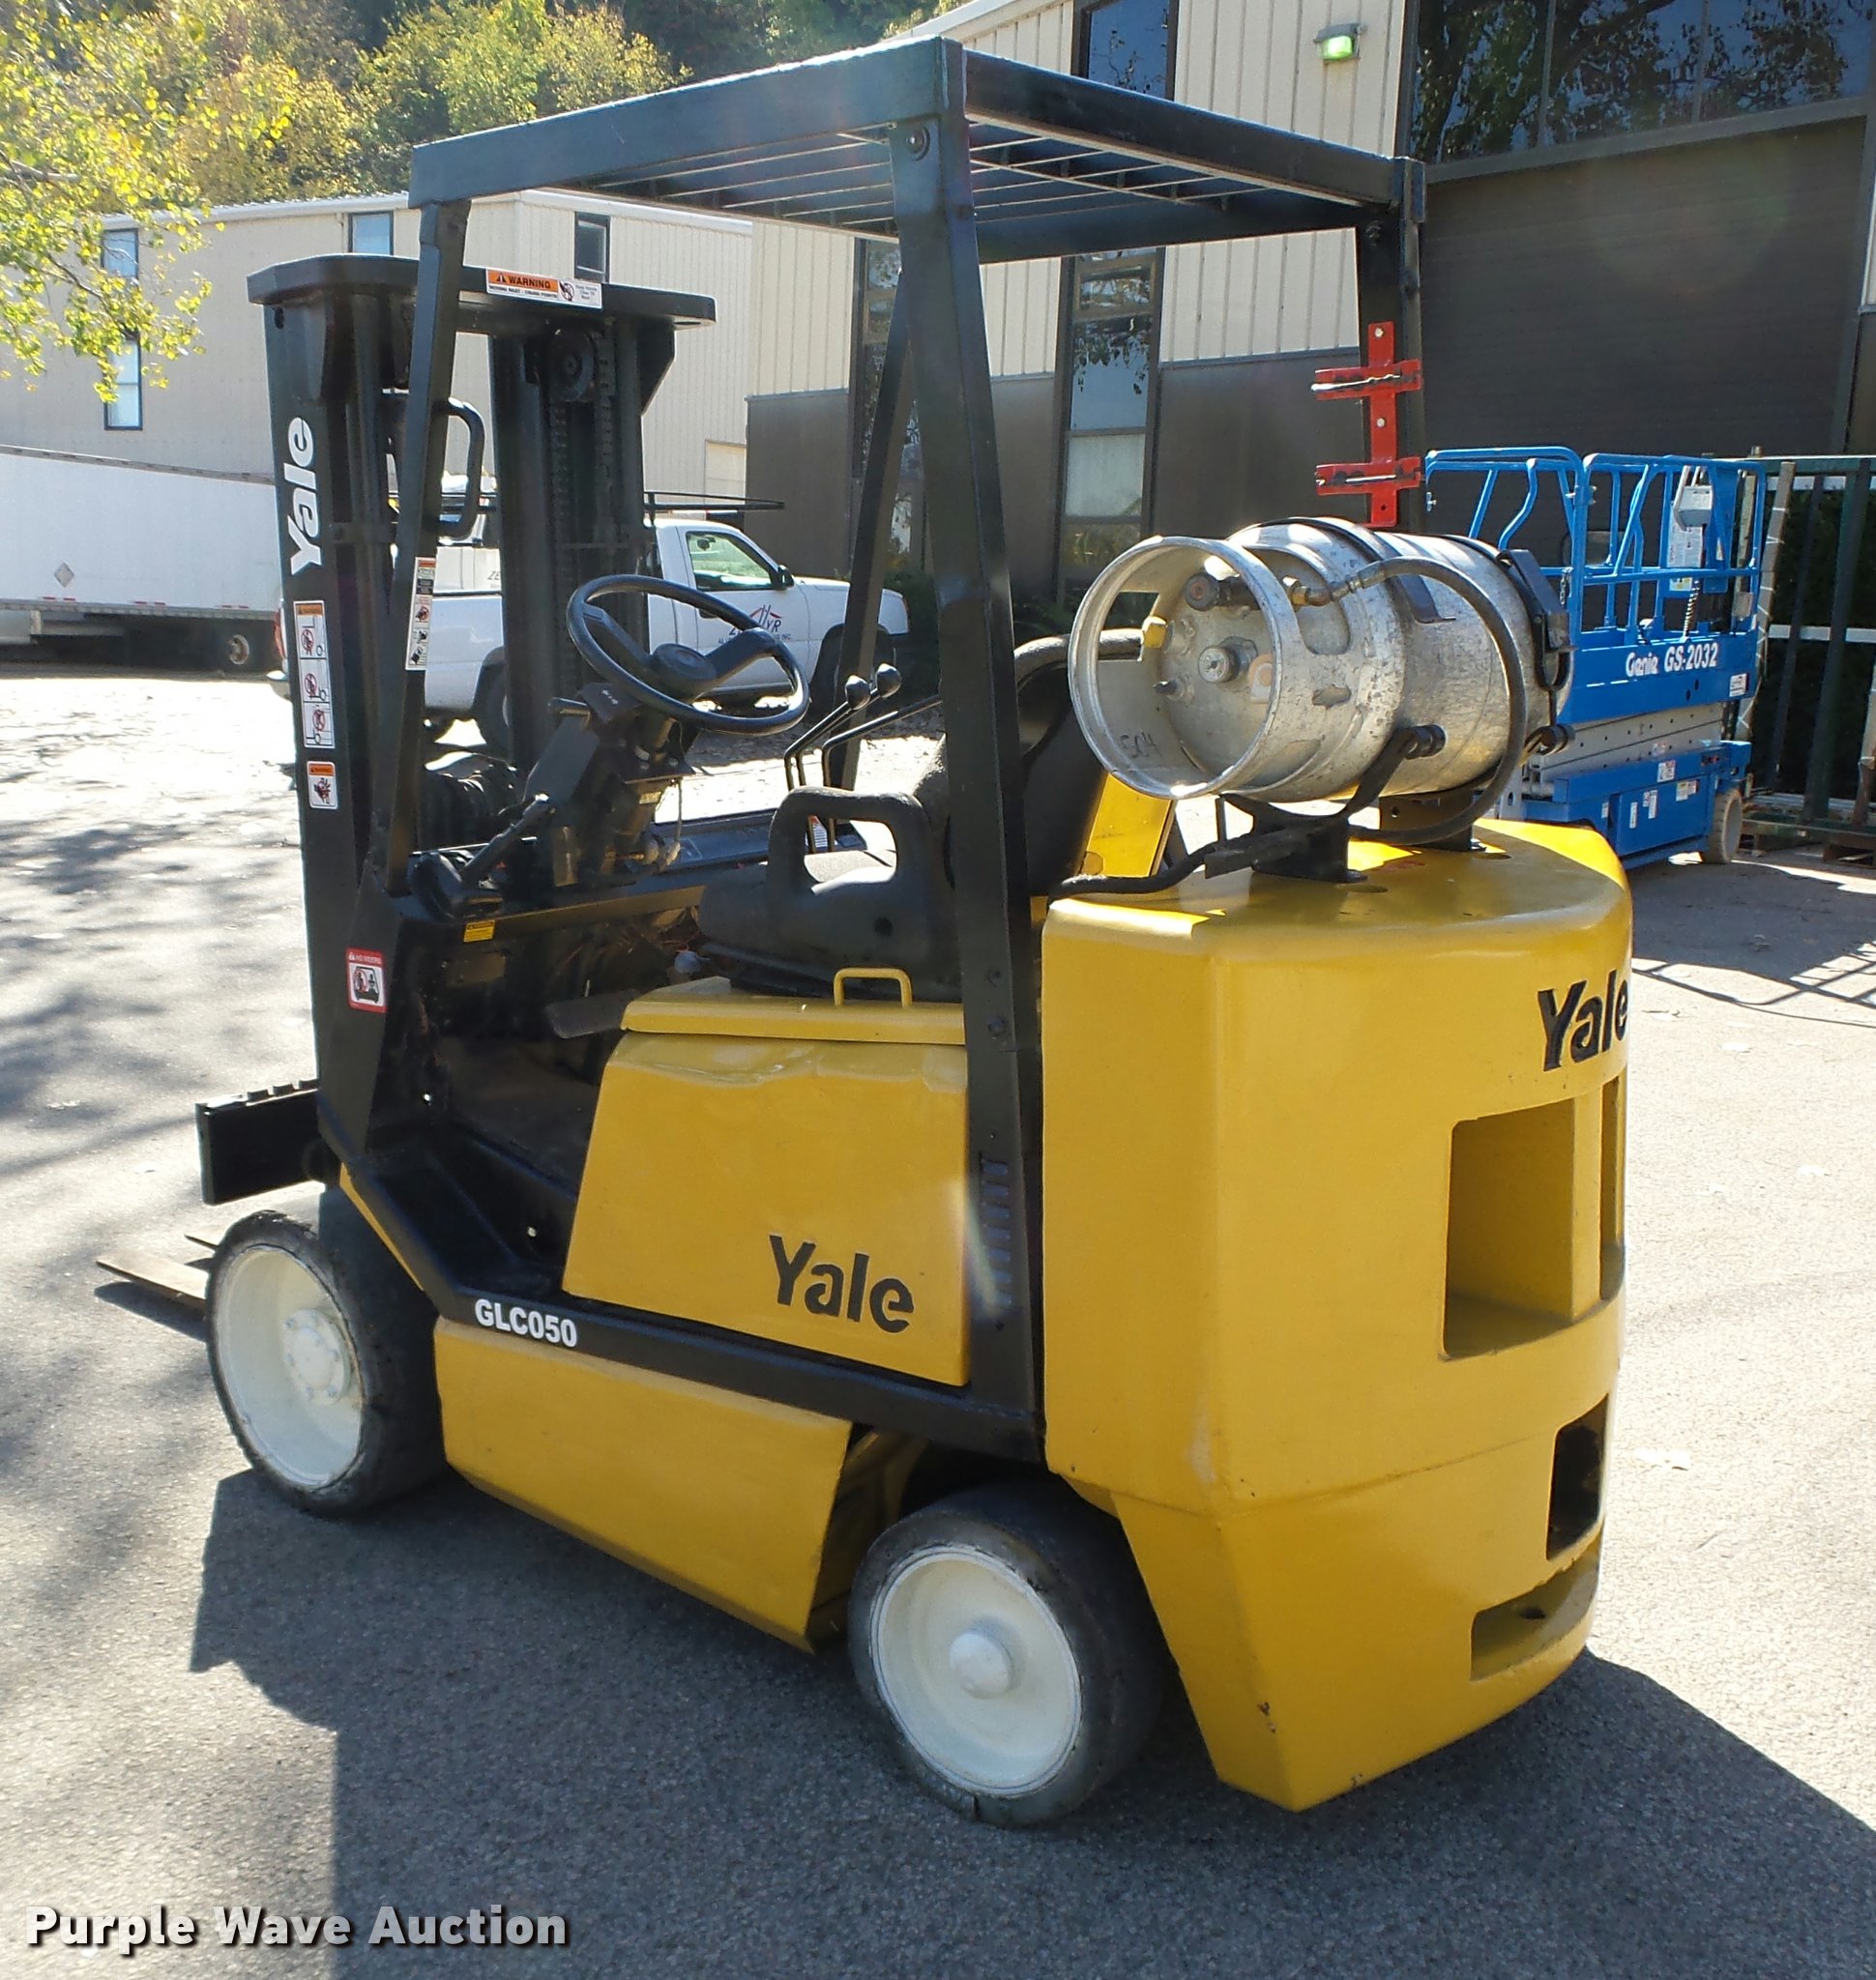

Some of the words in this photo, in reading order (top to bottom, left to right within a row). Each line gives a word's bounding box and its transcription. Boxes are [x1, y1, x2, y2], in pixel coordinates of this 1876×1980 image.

[509, 276, 550, 289] WARNING
[283, 417, 322, 575] Yale
[1626, 652, 1658, 677] Genie
[1664, 642, 1718, 673] GS-2032
[1538, 969, 1627, 1072] Yale
[769, 1235, 915, 1333] Yale
[475, 1298, 577, 1348] GLC050
